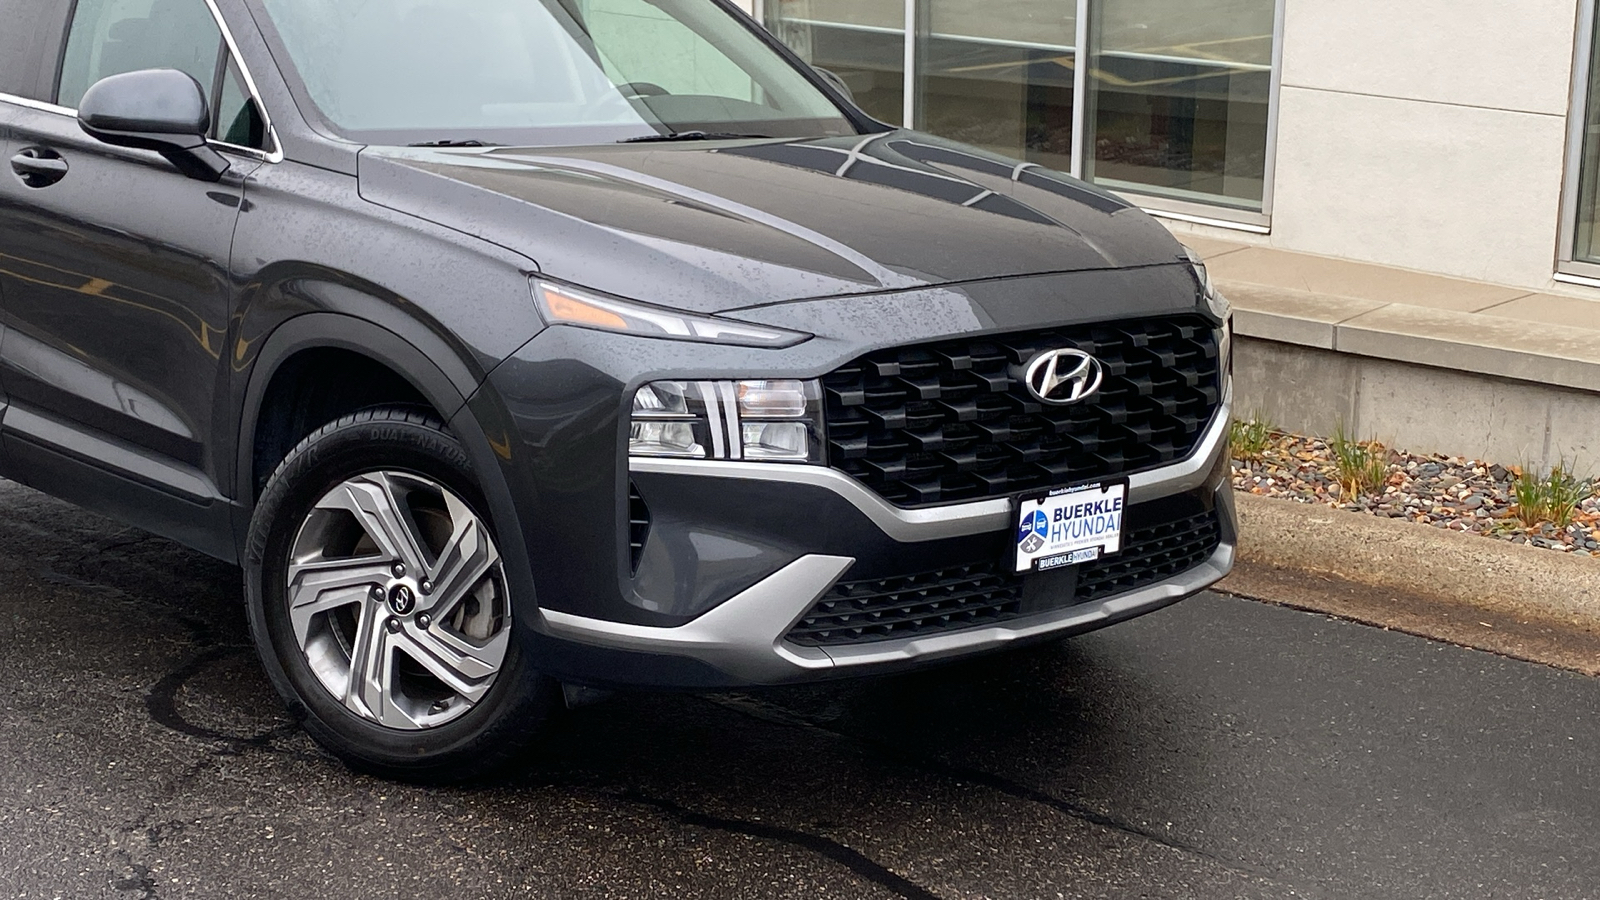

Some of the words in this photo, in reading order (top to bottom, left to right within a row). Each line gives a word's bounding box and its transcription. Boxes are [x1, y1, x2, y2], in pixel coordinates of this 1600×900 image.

[1053, 497, 1122, 522] BUERKLE
[1051, 513, 1120, 543] HYUNDAI
[1040, 553, 1073, 568] BUERKLE
